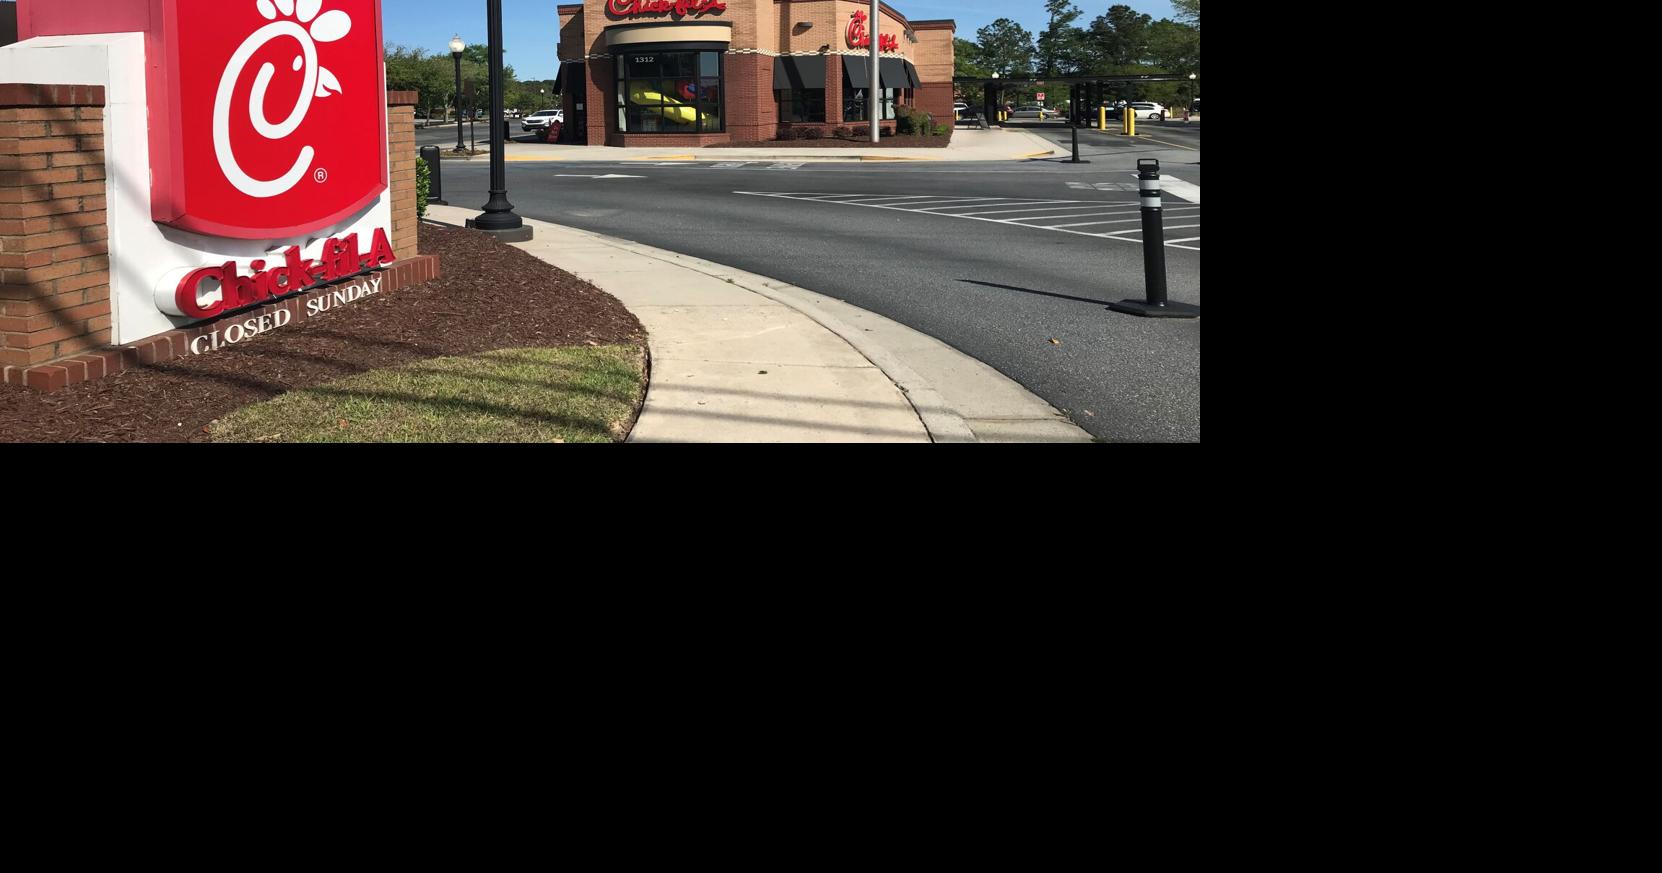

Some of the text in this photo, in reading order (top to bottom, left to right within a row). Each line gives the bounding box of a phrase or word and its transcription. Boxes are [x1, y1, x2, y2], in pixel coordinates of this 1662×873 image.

[175, 227, 396, 318] Chick-fil-A
[190, 278, 382, 355] CLOSED SUNDAY
